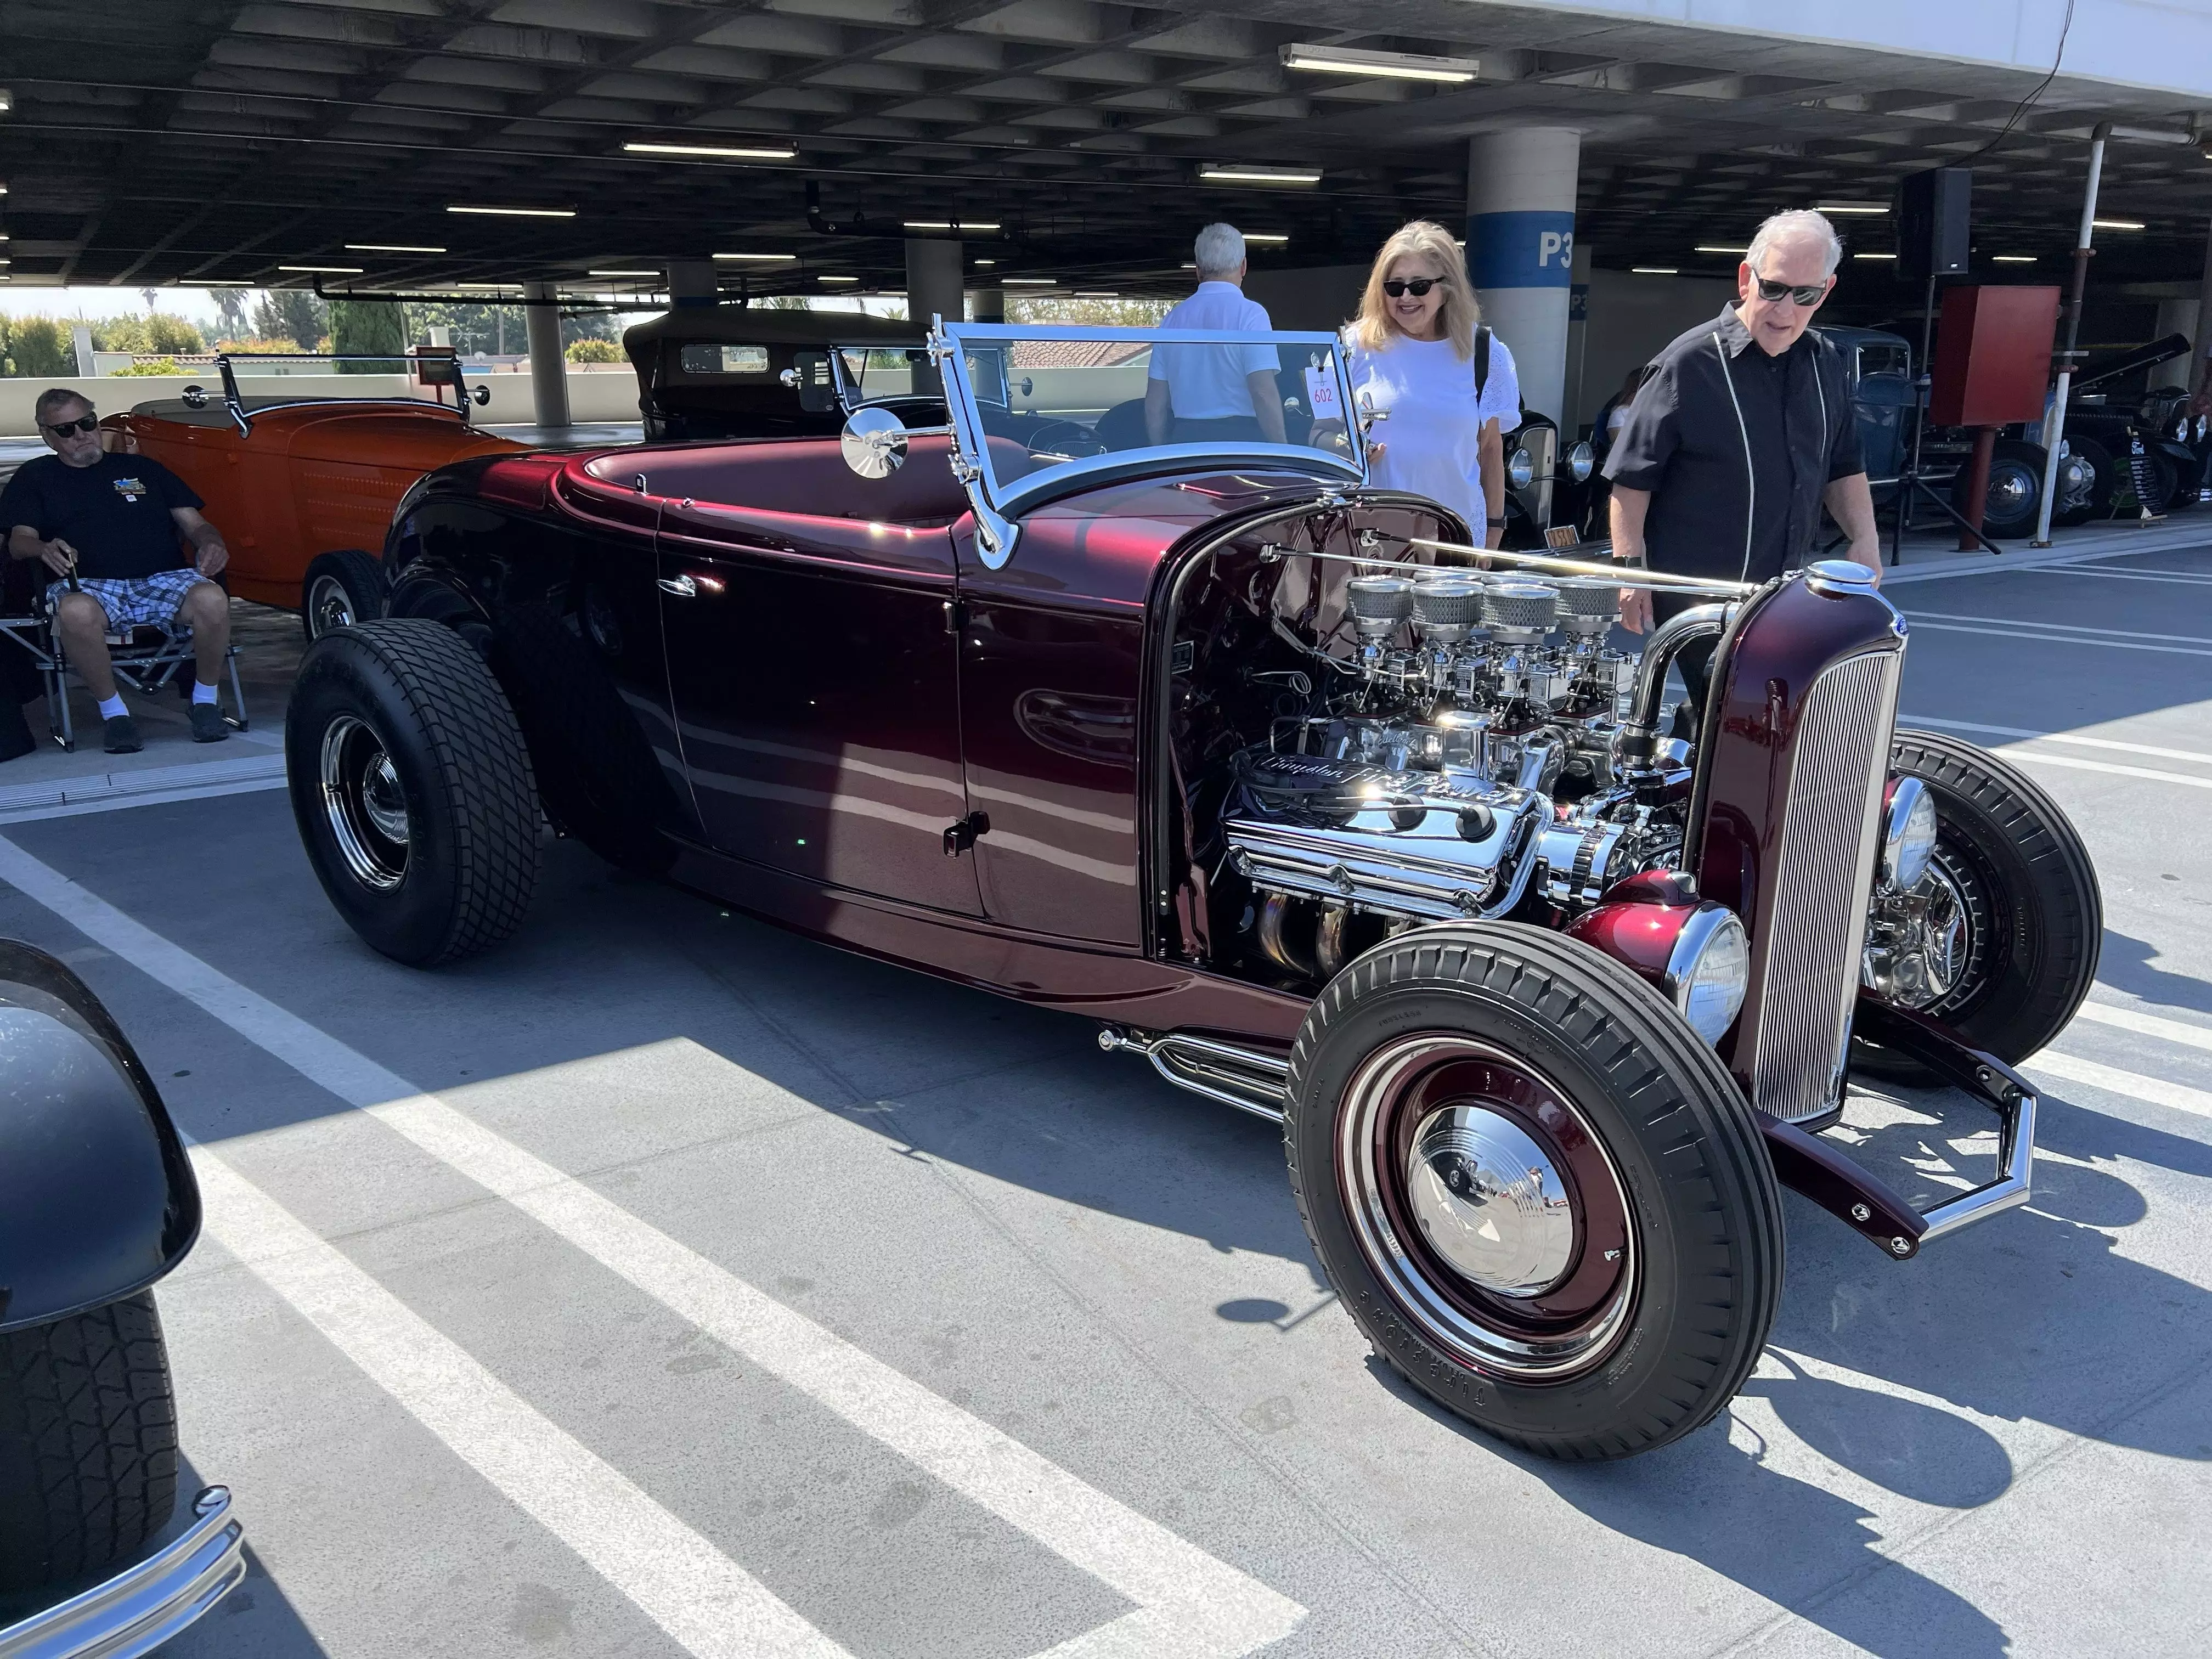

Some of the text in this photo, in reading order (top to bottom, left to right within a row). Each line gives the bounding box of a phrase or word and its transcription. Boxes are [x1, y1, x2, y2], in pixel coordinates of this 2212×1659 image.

[1539, 232, 1573, 268] P3
[1314, 388, 1333, 403] 602
[1360, 1290, 1486, 1406] Firestone
